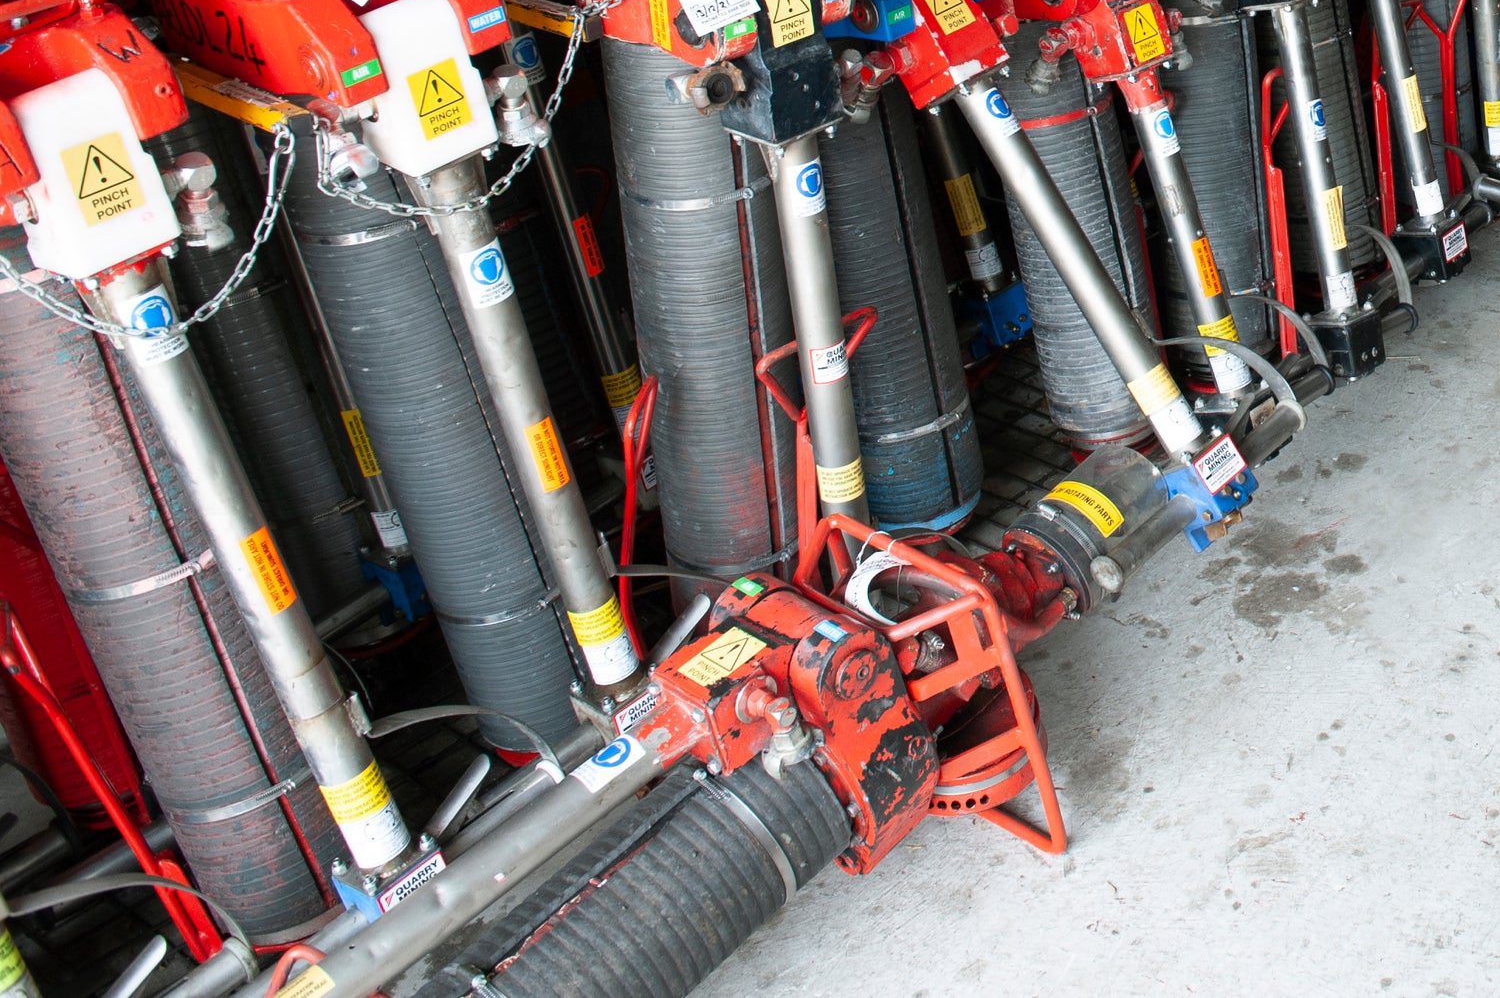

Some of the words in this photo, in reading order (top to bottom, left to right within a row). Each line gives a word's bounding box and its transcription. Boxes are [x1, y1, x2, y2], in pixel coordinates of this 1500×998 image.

[471, 10, 502, 30] WATER
[894, 10, 906, 22] AIR
[943, 9, 963, 22] PINCH
[948, 16, 968, 29] POINT
[733, 24, 747, 35] AIR
[781, 19, 805, 32] PINCH
[782, 29, 806, 42] POINT
[1139, 39, 1156, 51] PINCH
[1142, 48, 1159, 59] POINT
[351, 65, 370, 80] AIR
[429, 107, 459, 125] PINCH
[433, 117, 463, 134] POINT
[92, 188, 129, 209] PINCH
[96, 200, 133, 220] POINT
[547, 439, 556, 455] STORE
[1204, 441, 1230, 467] QUARRY
[1208, 450, 1232, 473] MINING
[1065, 486, 1094, 506] ROTATING
[1094, 502, 1115, 527] PARTS
[688, 668, 711, 683] POINT
[697, 660, 720, 676] PINCH
[395, 860, 439, 896] QUARRY
